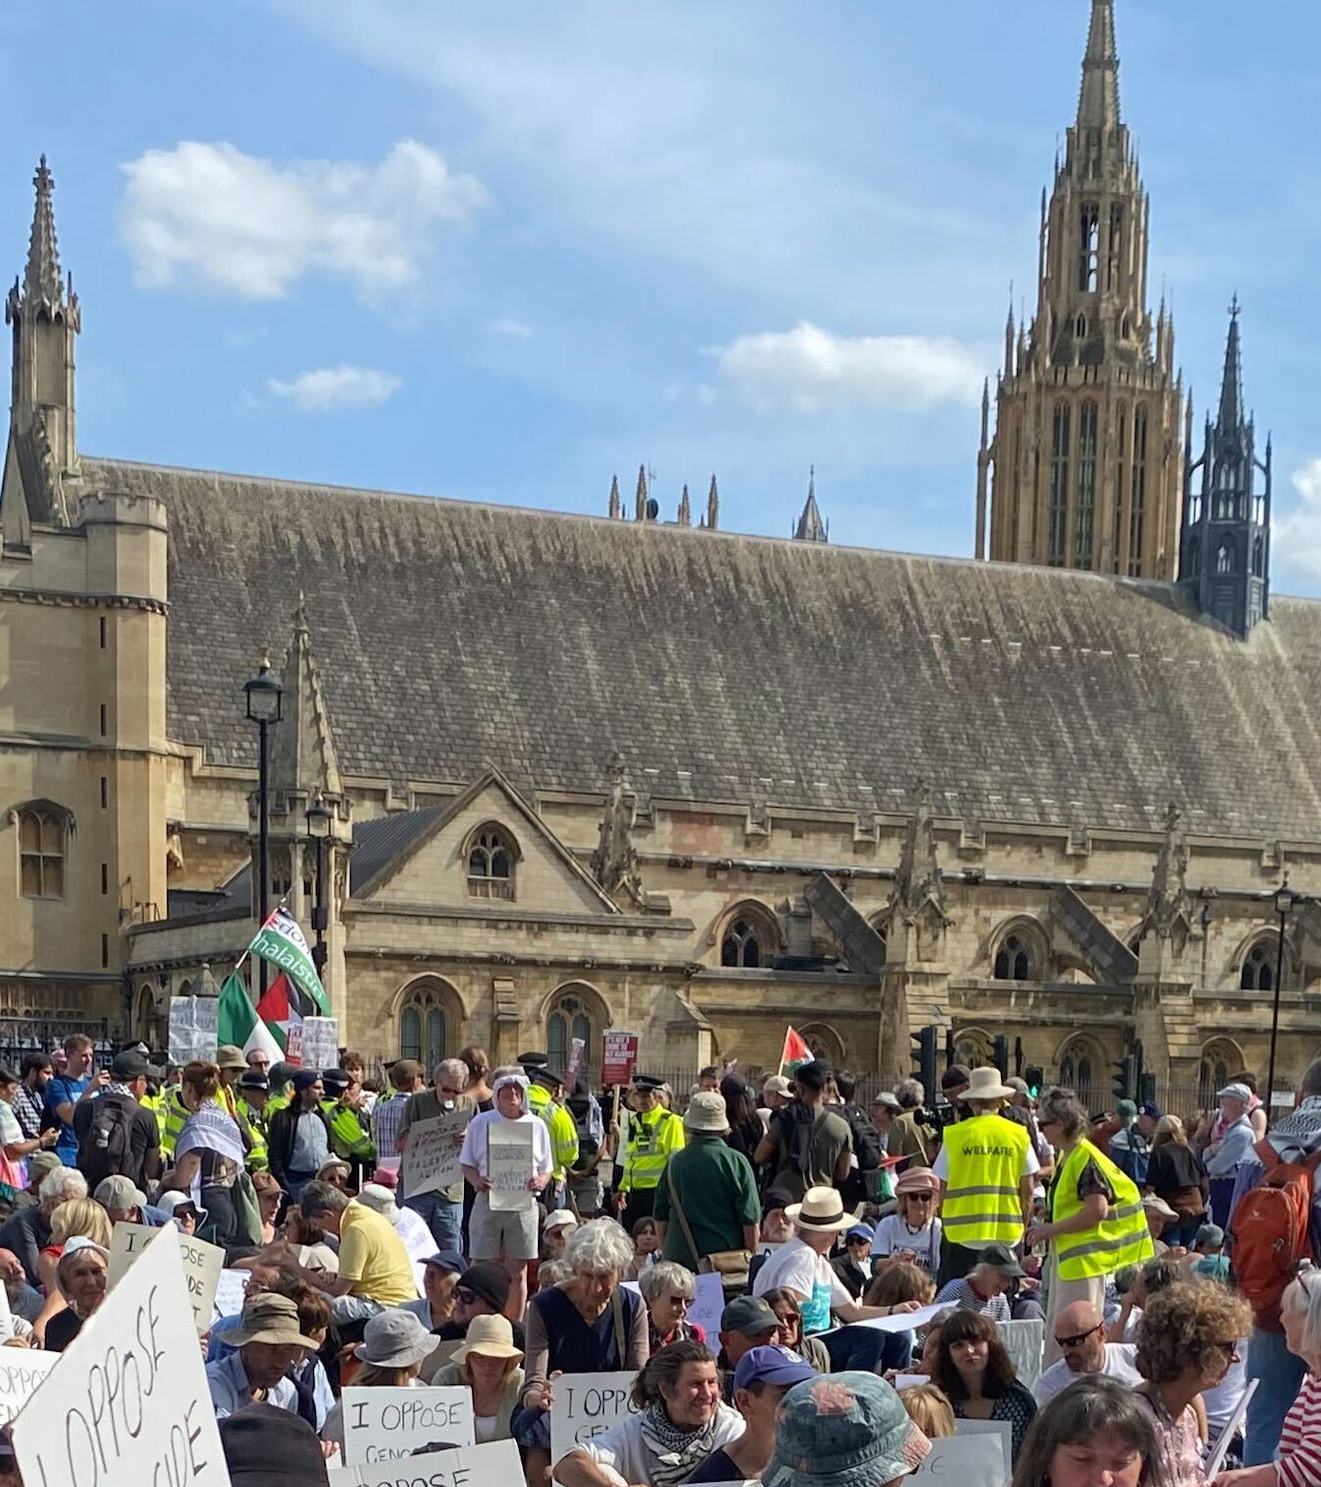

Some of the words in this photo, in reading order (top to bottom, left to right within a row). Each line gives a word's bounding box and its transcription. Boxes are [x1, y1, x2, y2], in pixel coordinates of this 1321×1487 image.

[962, 1146, 1015, 1157] WELFARE
[351, 1402, 369, 1429] I
[381, 1401, 465, 1431] OPPOSE
[567, 1388, 574, 1418] I
[584, 1388, 641, 1416] OPPO
